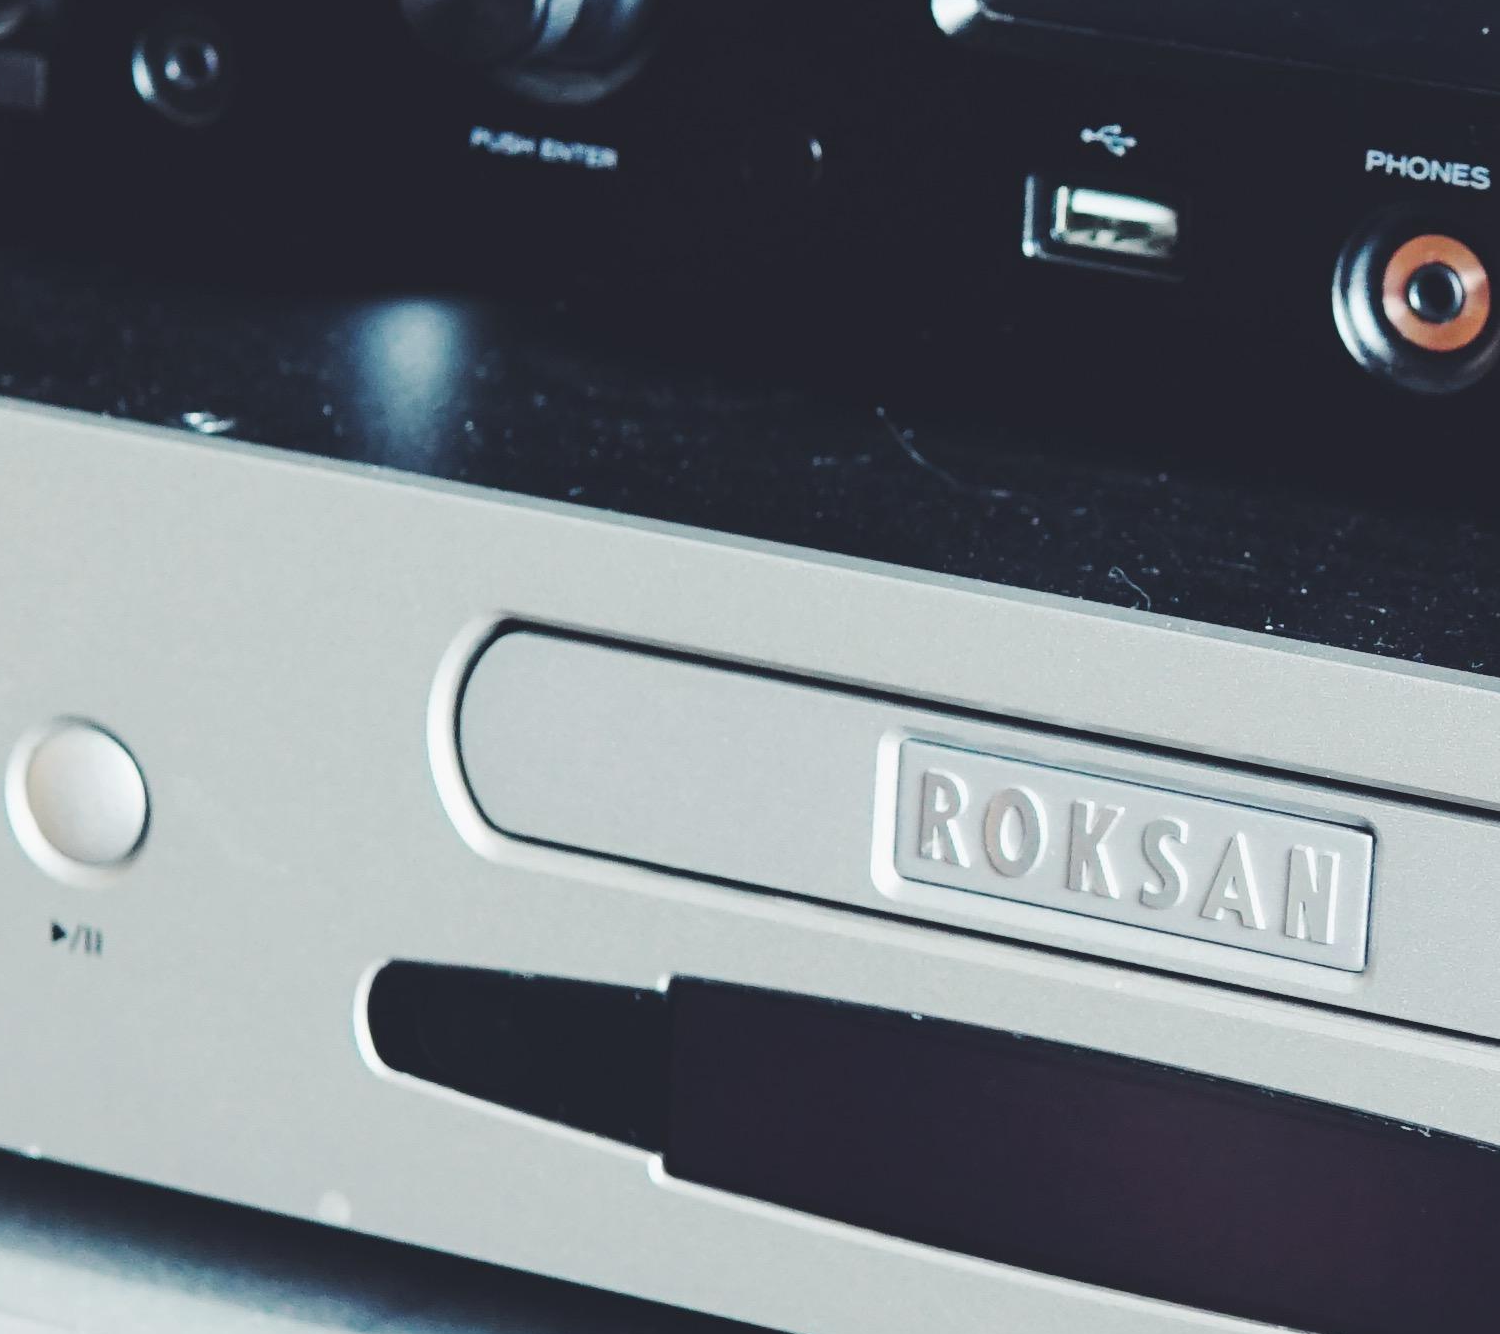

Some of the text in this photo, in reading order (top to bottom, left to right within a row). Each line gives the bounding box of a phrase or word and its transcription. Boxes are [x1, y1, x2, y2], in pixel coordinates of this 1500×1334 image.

[469, 124, 619, 170] PUSH ENTER
[1365, 150, 1492, 191] PHONES
[918, 768, 1341, 945] ROKSAN
